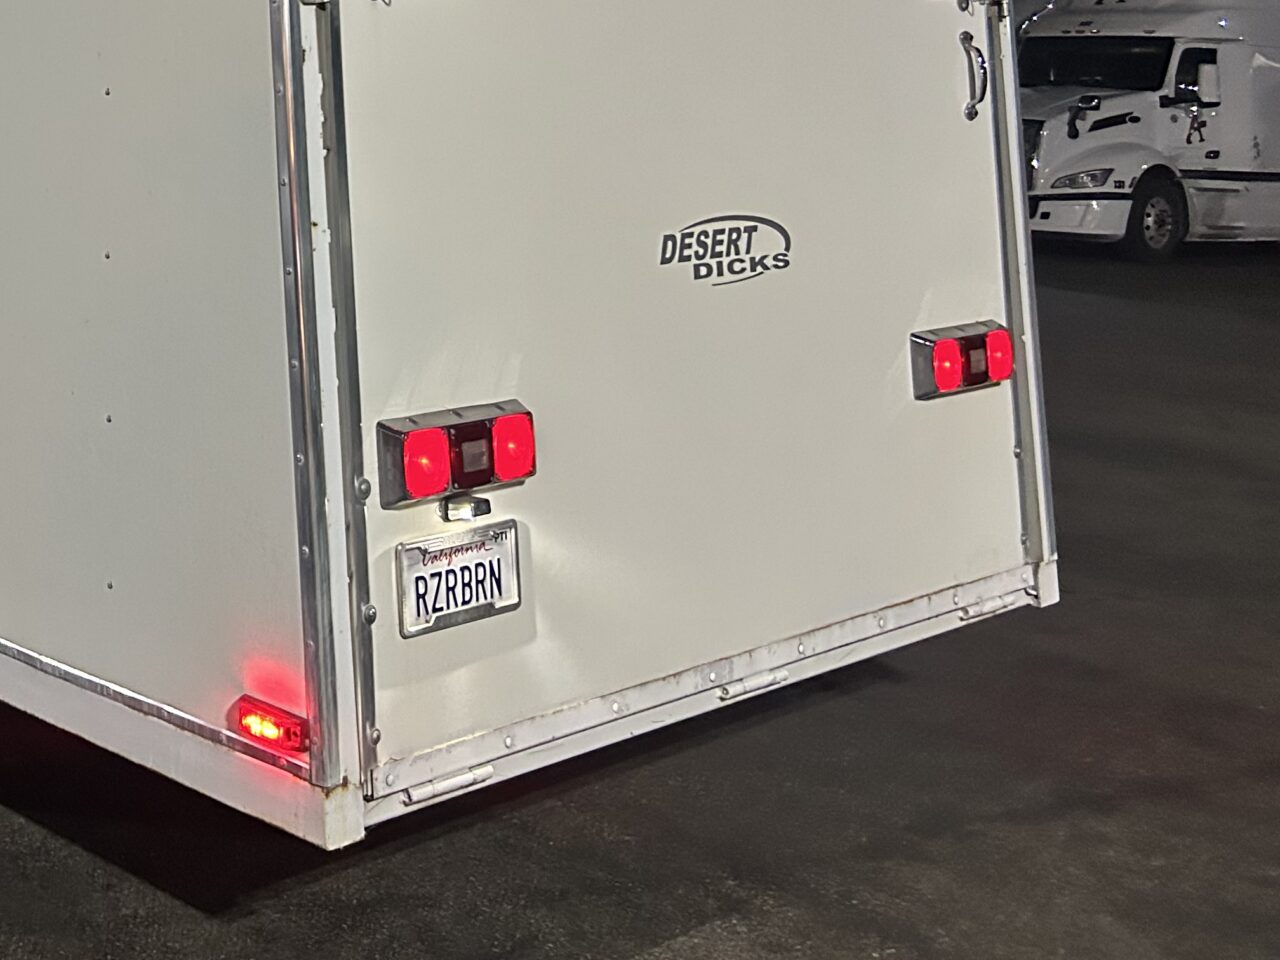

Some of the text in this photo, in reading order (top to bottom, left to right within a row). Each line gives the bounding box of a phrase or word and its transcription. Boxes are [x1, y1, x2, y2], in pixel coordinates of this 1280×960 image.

[660, 225, 758, 265] DESERT
[693, 253, 790, 280] DICKS
[414, 557, 503, 618] RZRBRN
